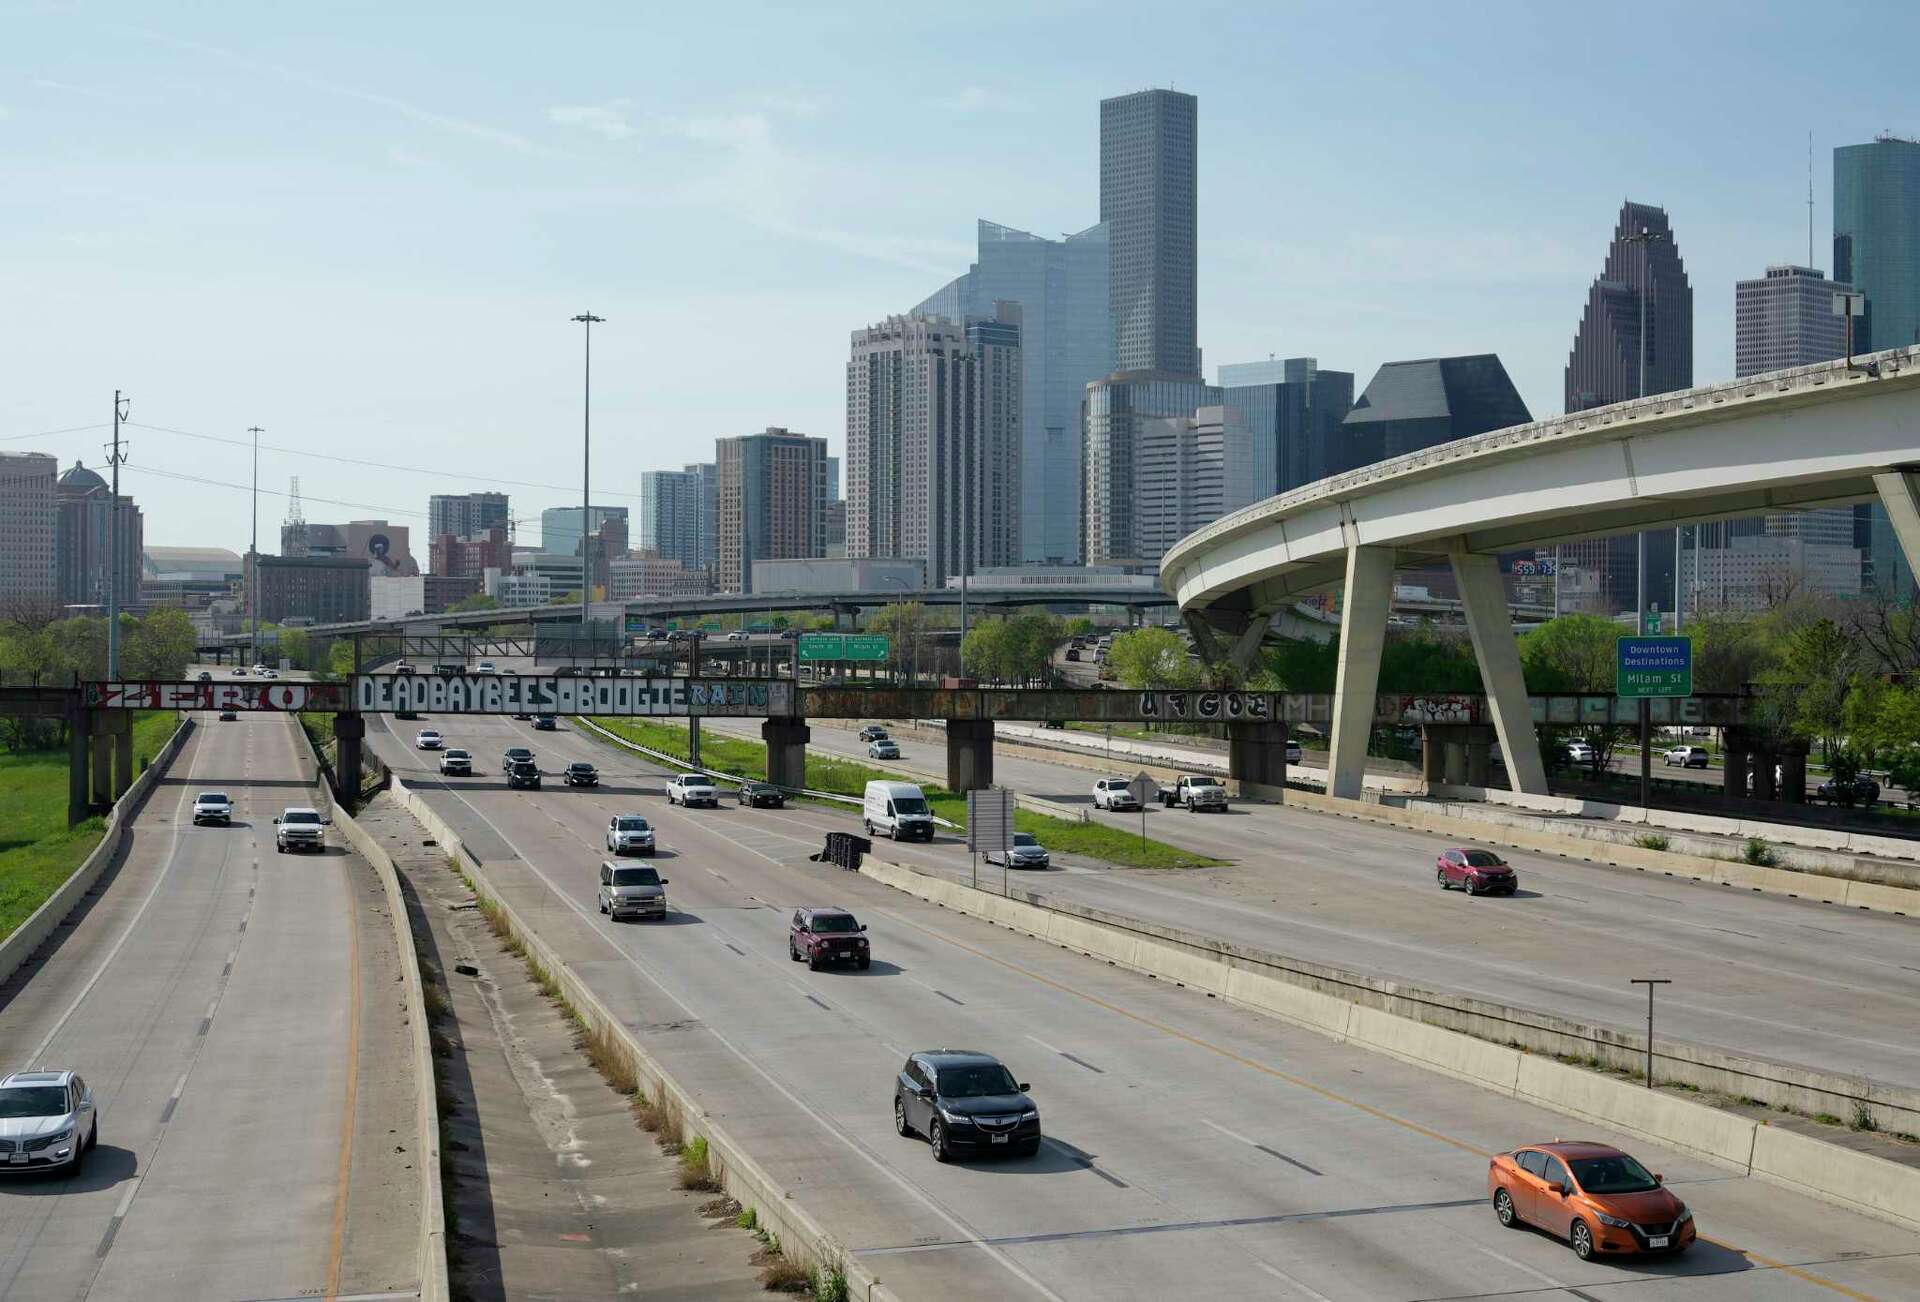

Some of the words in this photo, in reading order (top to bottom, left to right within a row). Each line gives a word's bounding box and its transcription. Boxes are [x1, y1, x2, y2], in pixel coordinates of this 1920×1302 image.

[1630, 646, 1679, 654] Downtown
[1624, 657, 1686, 666] Destinations
[1627, 674, 1662, 683] Milam
[1671, 674, 1681, 683] St
[104, 683, 306, 709] ZERO
